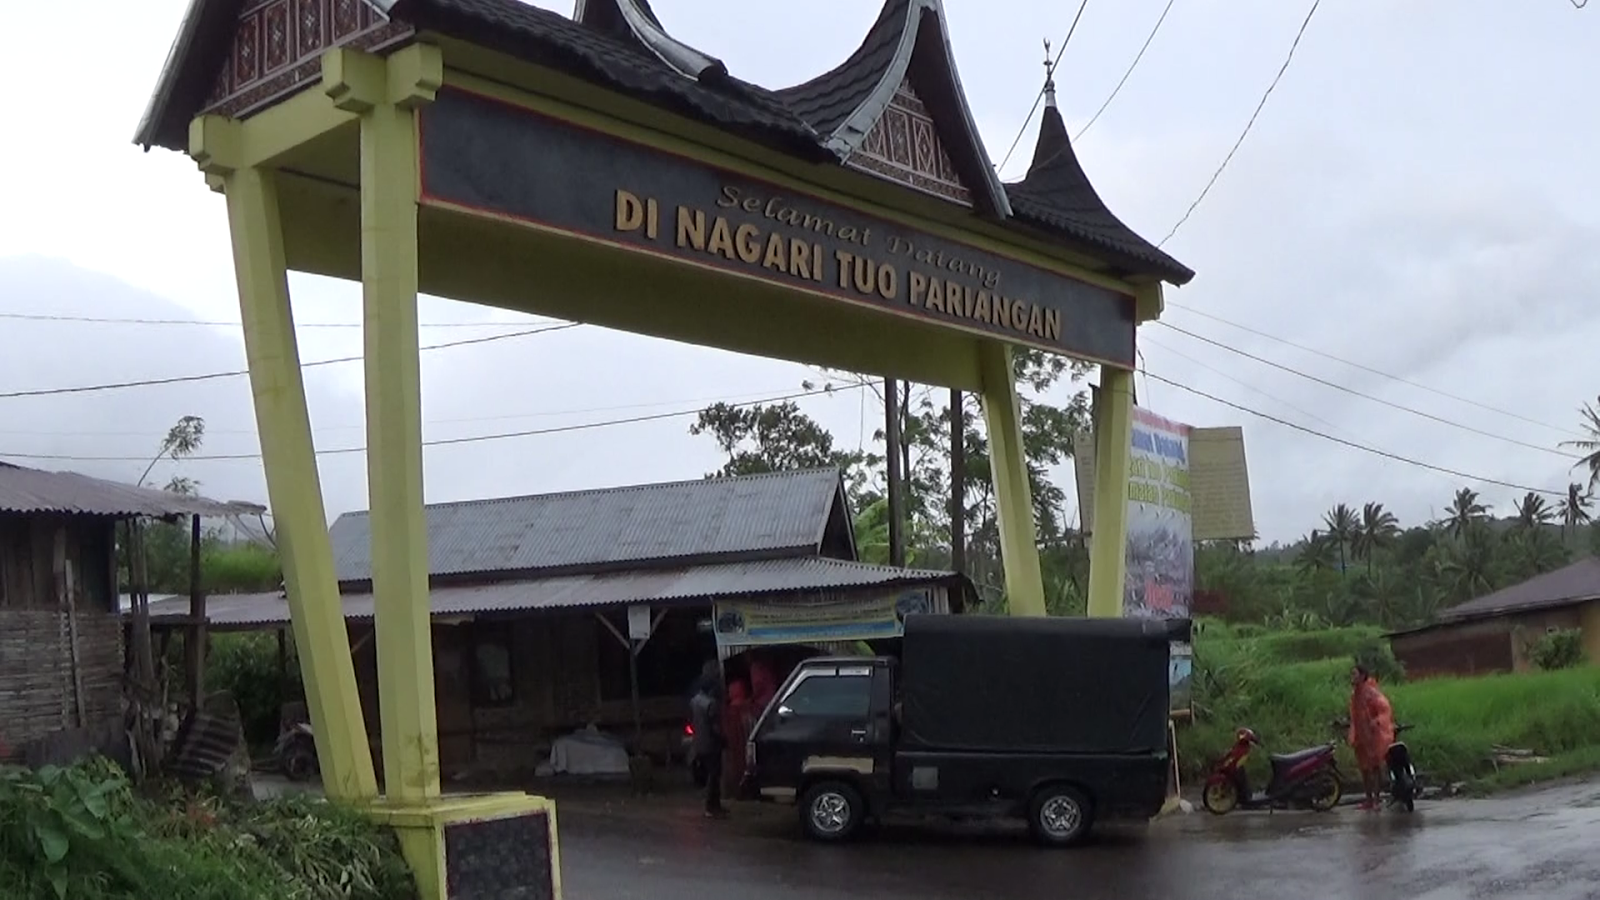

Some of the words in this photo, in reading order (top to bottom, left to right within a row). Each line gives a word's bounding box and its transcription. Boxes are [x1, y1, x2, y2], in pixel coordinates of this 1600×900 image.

[615, 189, 658, 240] DI
[677, 205, 823, 281] NAGARI
[835, 249, 898, 299] TUO
[909, 271, 1062, 341] PARIANGAN
[717, 186, 871, 246] Selamat
[887, 235, 1001, 289] Datang
